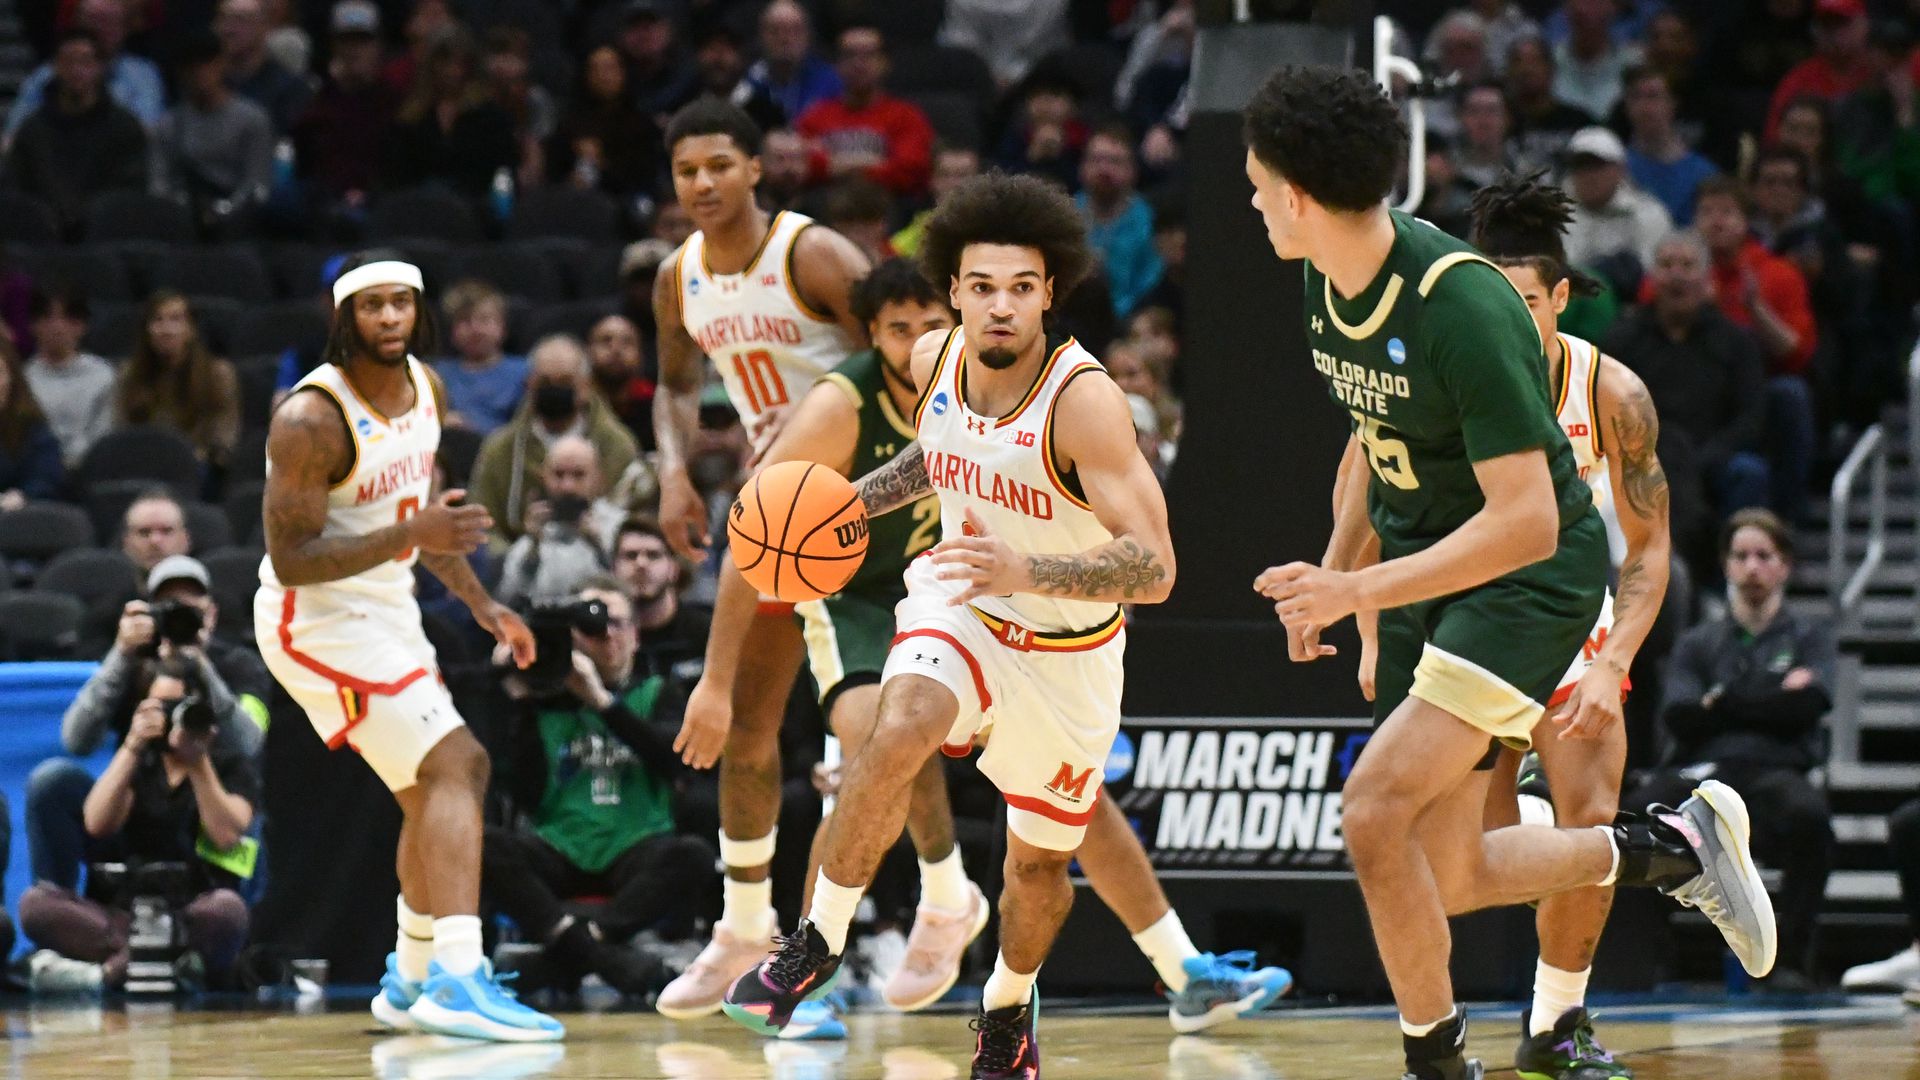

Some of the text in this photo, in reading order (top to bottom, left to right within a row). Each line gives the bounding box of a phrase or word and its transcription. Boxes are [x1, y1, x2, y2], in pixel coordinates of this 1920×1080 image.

[732, 348, 789, 415] 10
[1312, 349, 1410, 398] COLORADO
[1333, 380, 1389, 415] STATE
[833, 512, 868, 549] Wil
[1032, 560, 1153, 588] FEARLESS
[1006, 623, 1028, 646] M
[1133, 731, 1335, 790] MARCH
[1046, 761, 1096, 799] M
[1155, 790, 1343, 850] MADNE
